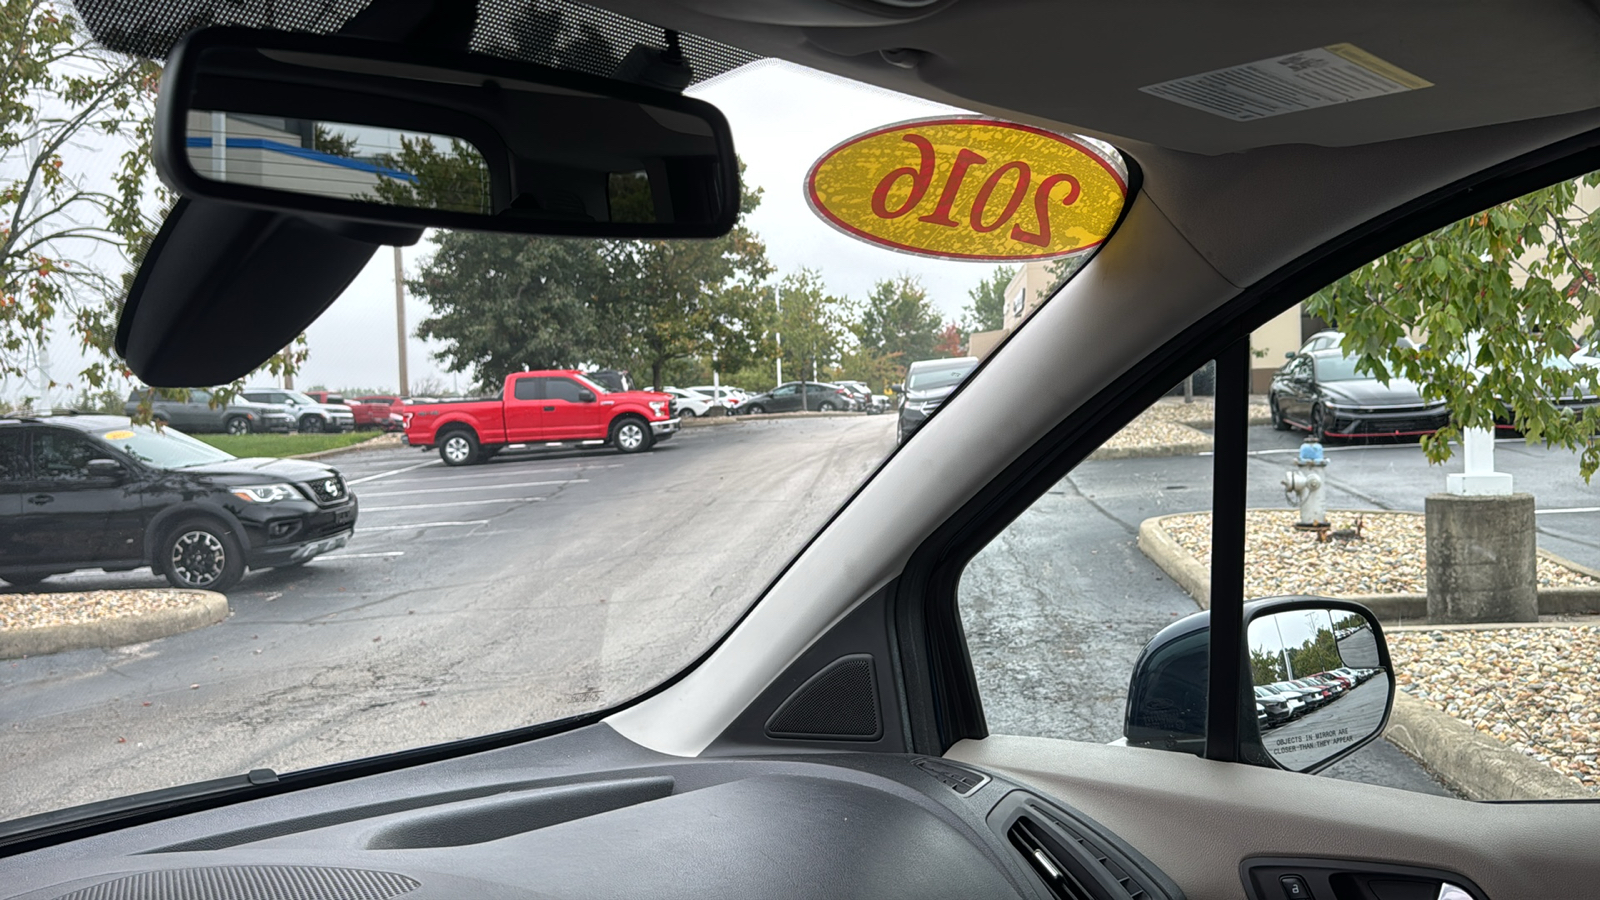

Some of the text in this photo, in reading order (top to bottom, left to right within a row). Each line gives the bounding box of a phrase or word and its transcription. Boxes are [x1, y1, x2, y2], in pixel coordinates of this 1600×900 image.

[1274, 746, 1297, 755] CLOSER
[1316, 740, 1330, 748] THEY
[1333, 736, 1354, 744] APPEAR
[1276, 736, 1302, 746] OBJECTS
[1316, 730, 1336, 739] MIRROR
